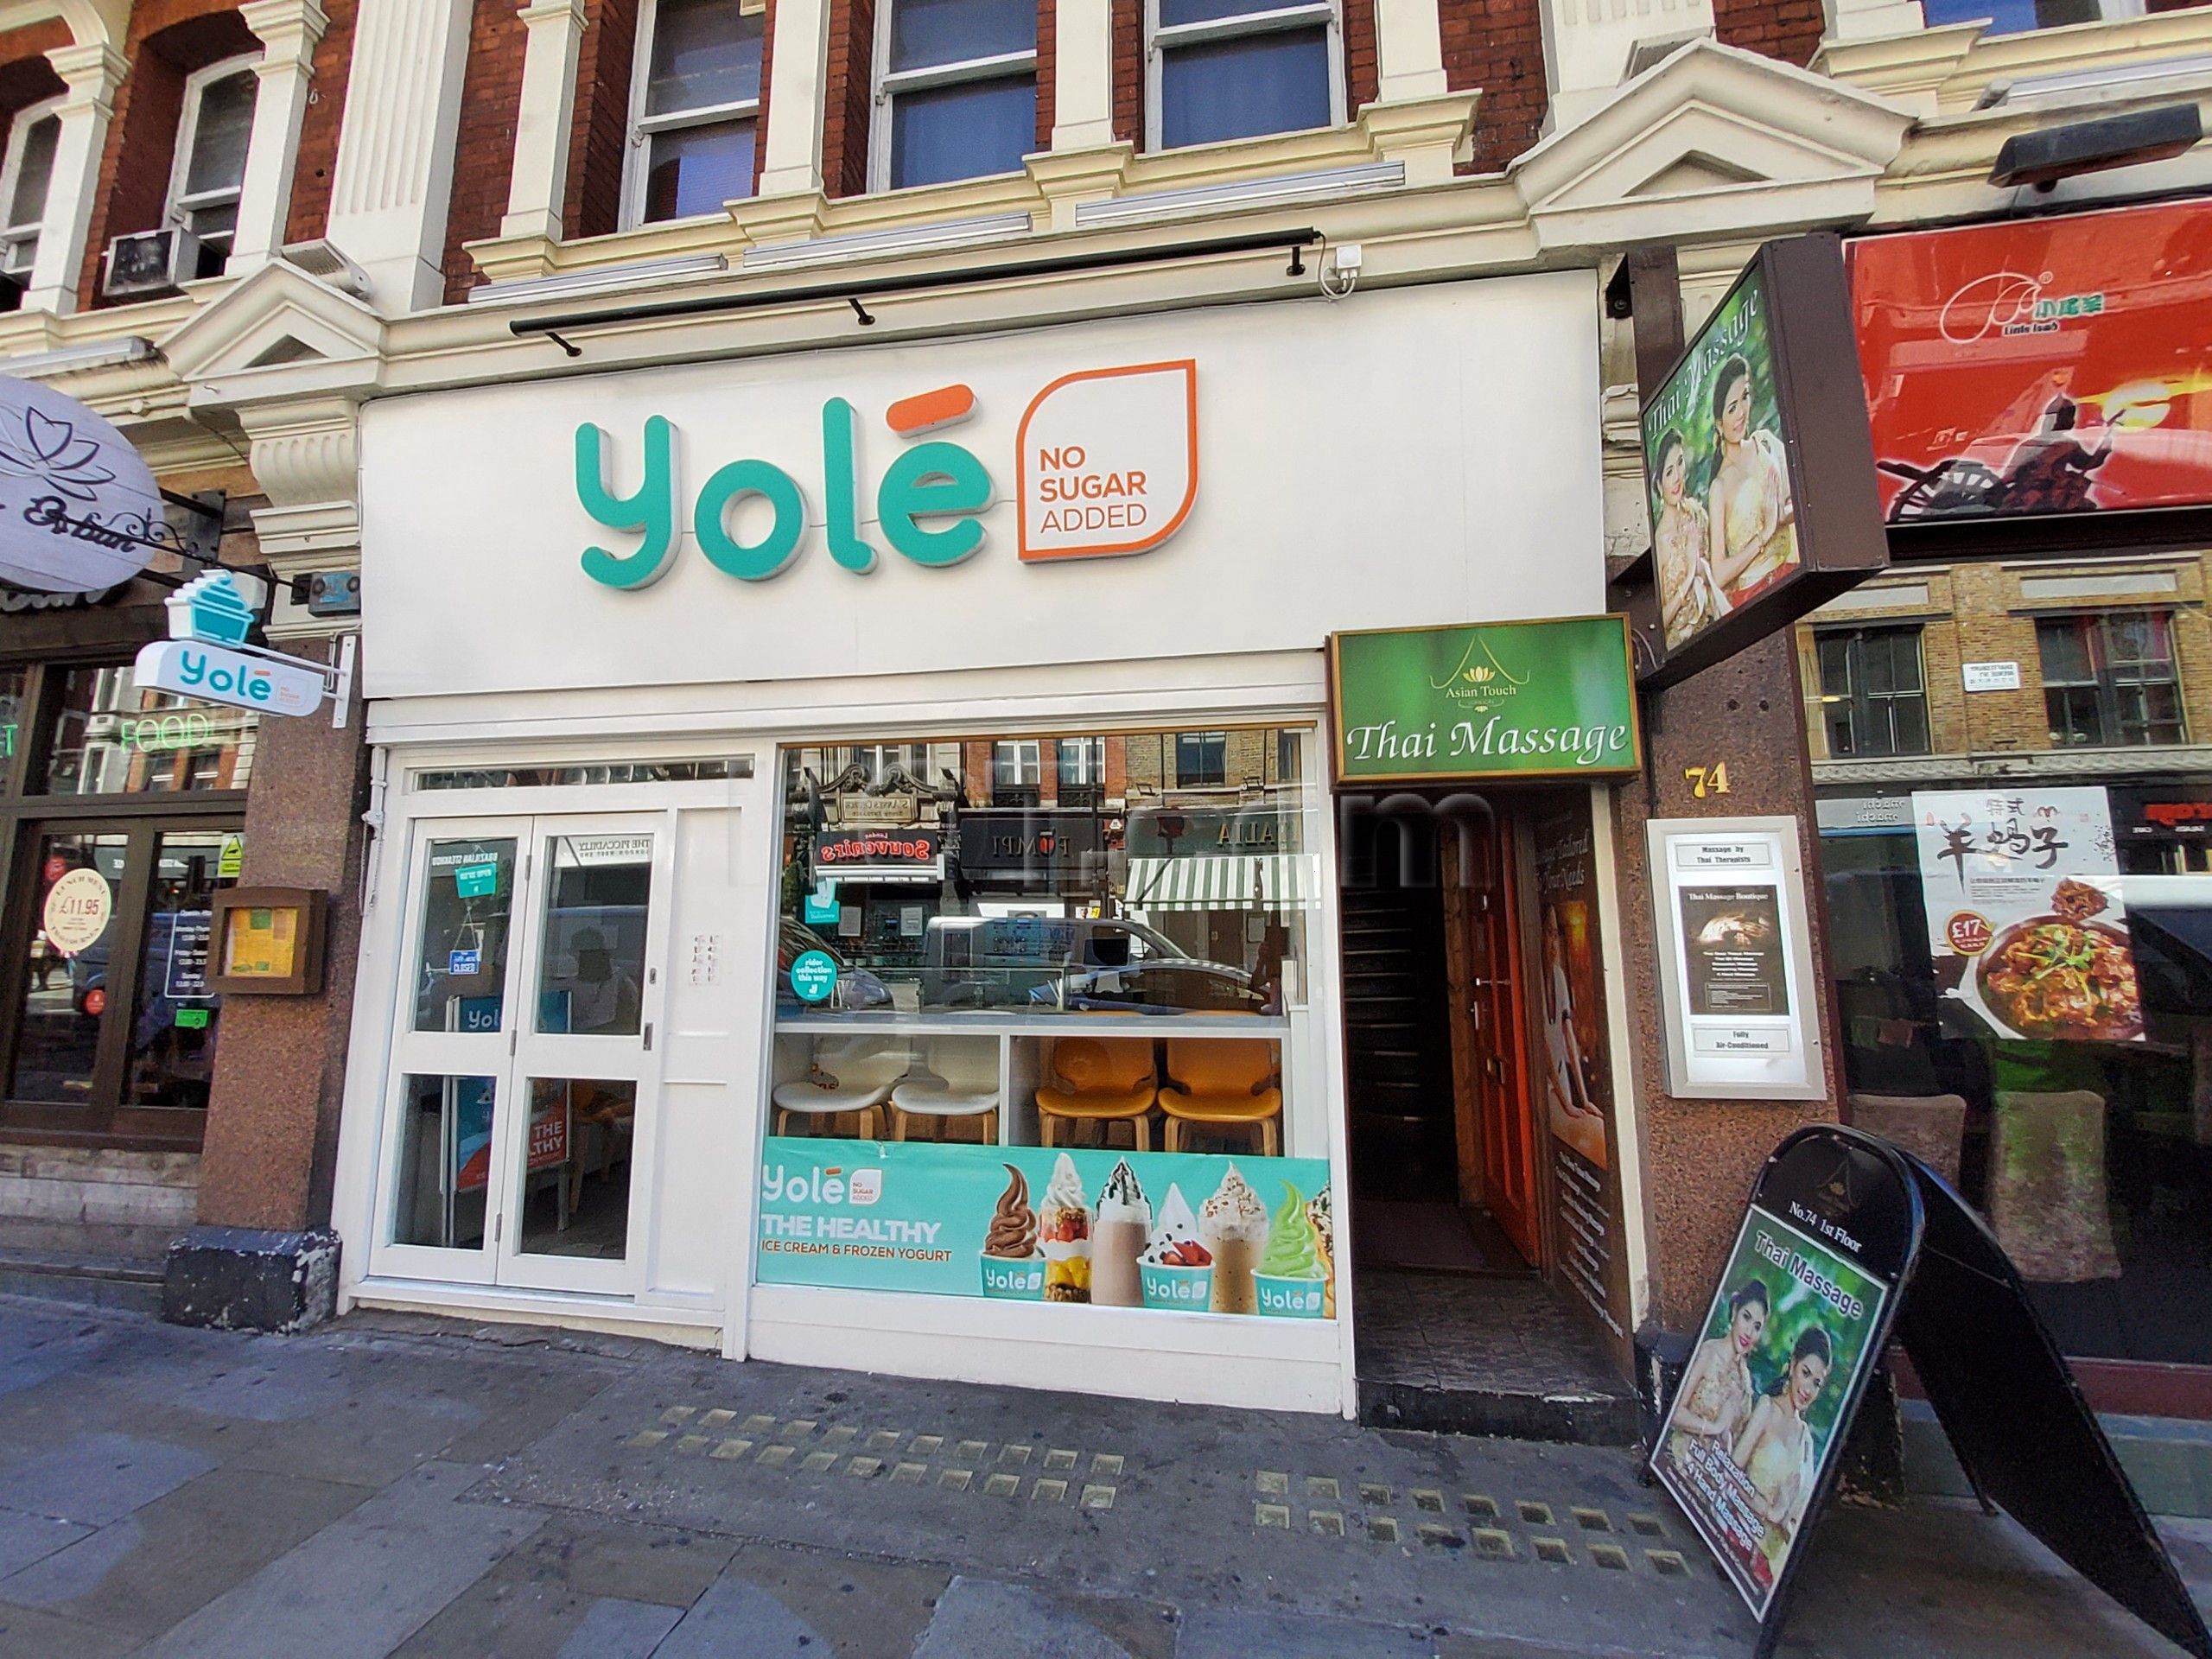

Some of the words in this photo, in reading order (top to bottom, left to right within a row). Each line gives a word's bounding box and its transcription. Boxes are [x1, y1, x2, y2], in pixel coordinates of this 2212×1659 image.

[1039, 446, 1087, 472] NO
[1039, 471, 1148, 503] SUGAR
[1039, 503, 1148, 534] ADDED
[1446, 686, 1478, 698] Asian
[1480, 676, 1516, 696] Touch
[121, 713, 209, 754] FOOD
[1346, 720, 1437, 760] Thai
[1450, 715, 1628, 766] Massage
[1684, 762, 1730, 798] 74
[59, 896, 100, 915] £11.95
[1952, 918, 1981, 938] £17
[813, 975, 828, 983] way
[534, 1121, 563, 1140] THE
[760, 1213, 812, 1237] THE
[817, 1217, 941, 1244] HEALTHY
[1789, 1201, 1819, 1226] No.74
[1820, 1219, 1833, 1237] 1st
[1834, 1226, 1863, 1253] Floor
[761, 1240, 781, 1251] ICE
[784, 1242, 829, 1255] CREAM
[832, 1244, 841, 1255] &
[844, 1245, 894, 1258] FROZEN
[897, 1248, 952, 1262] YOGURT
[1755, 1230, 1790, 1269] Thai
[1788, 1252, 1864, 1320] Massage
[1712, 1440, 1756, 1499] Relaxation
[1689, 1439, 1707, 1464] Full
[1705, 1457, 1727, 1490] Body
[1727, 1483, 1765, 1538] Massage
[1687, 1462, 1694, 1473] 4
[1694, 1470, 1717, 1502] Hand
[1715, 1496, 1753, 1551] Massage
